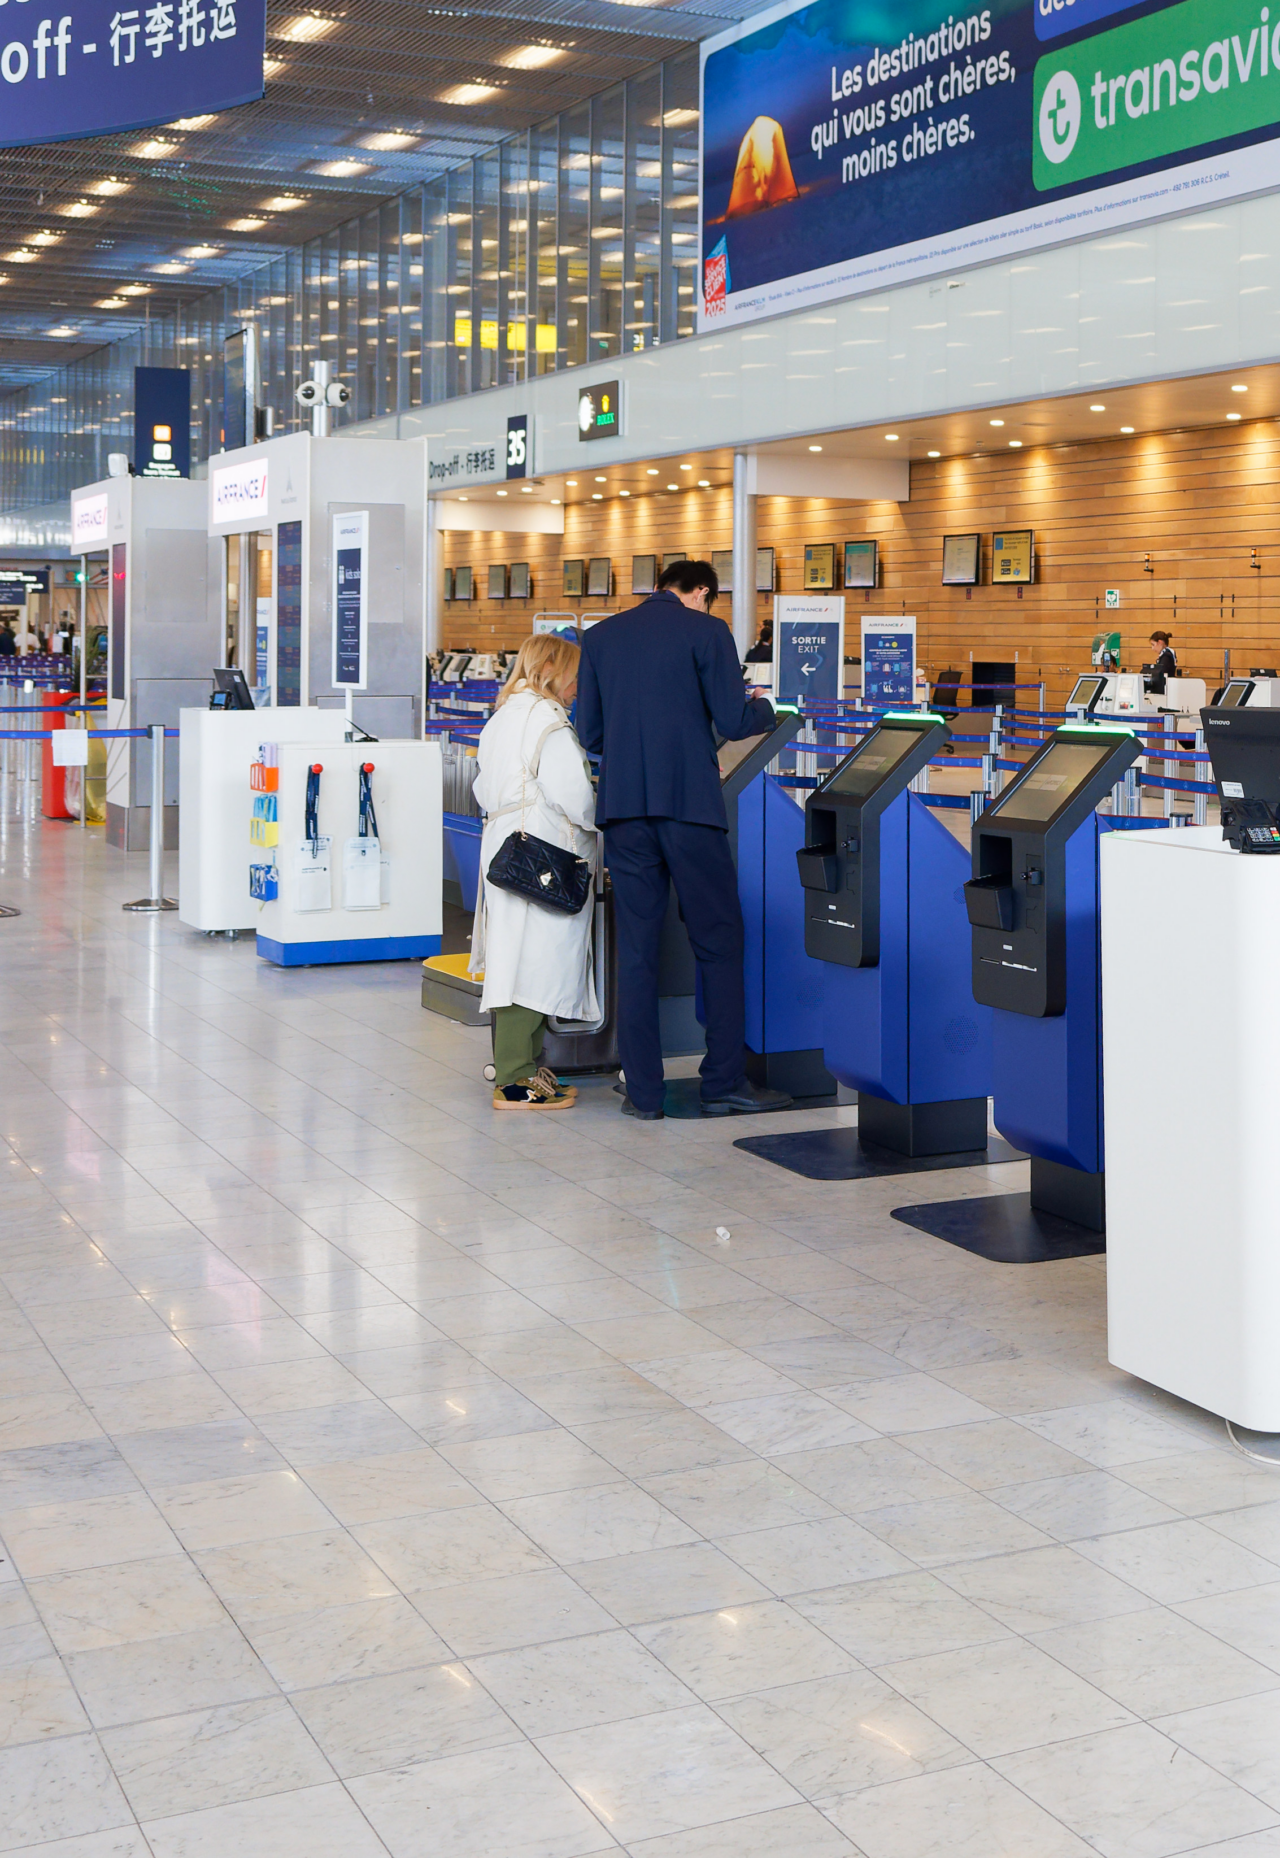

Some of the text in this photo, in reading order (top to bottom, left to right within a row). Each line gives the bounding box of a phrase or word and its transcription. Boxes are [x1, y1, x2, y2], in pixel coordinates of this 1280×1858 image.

[1, 16, 72, 83] off
[109, 0, 237, 66] 行李托运
[831, 10, 991, 101] Les destinations
[811, 50, 1016, 160] qui vous sont chères,
[842, 114, 975, 183] moins chères.
[705, 298, 726, 317] 2025
[507, 429, 526, 466] 35
